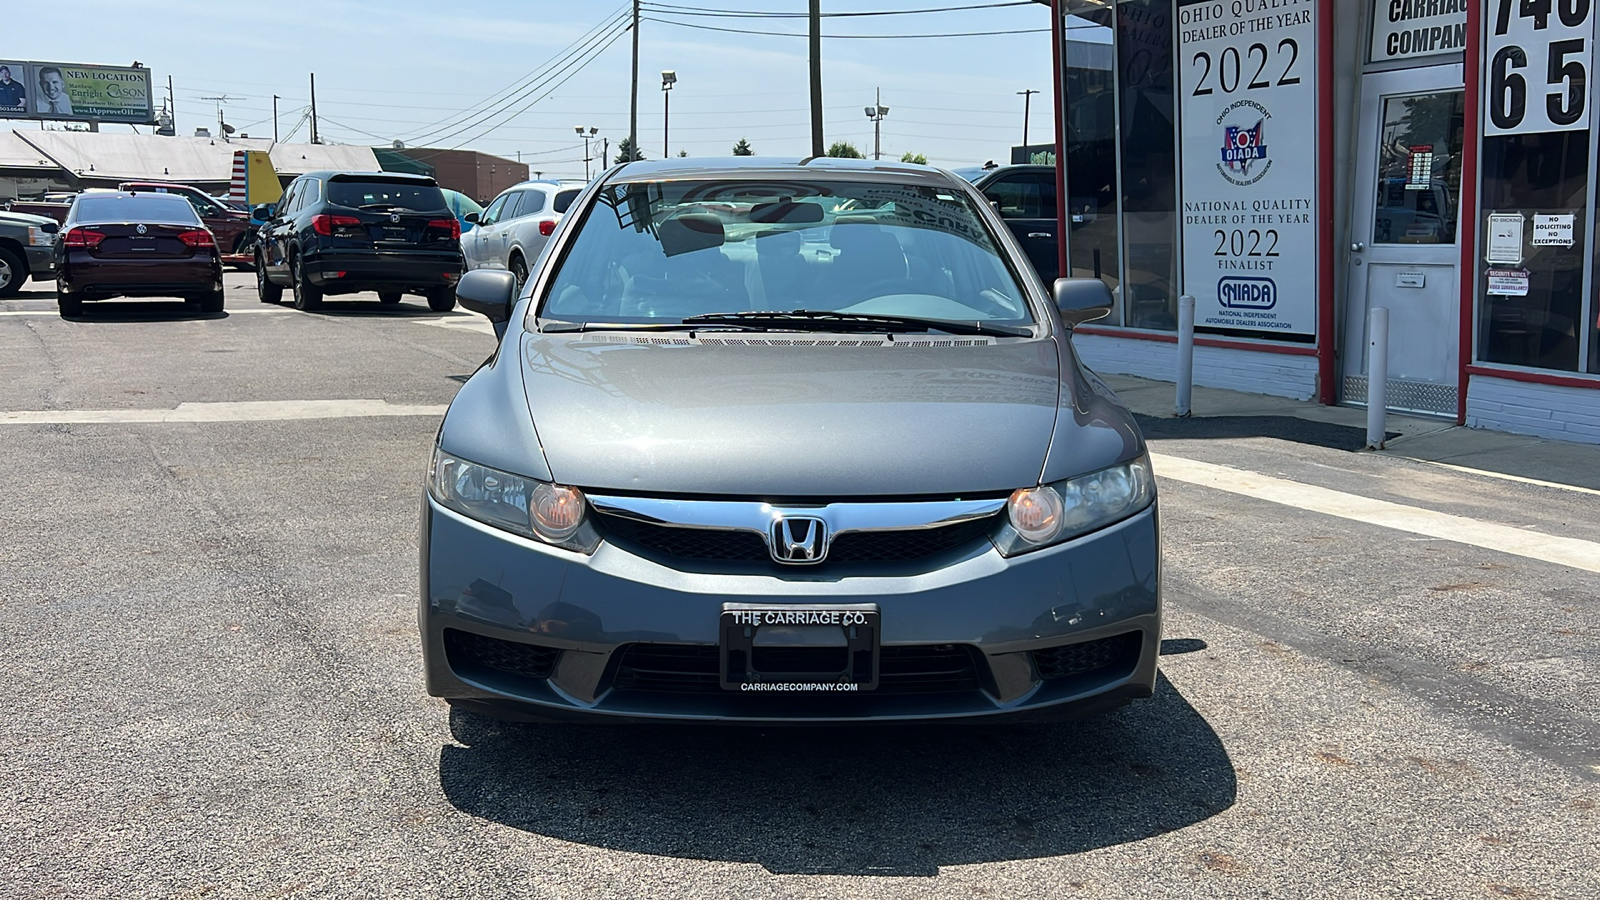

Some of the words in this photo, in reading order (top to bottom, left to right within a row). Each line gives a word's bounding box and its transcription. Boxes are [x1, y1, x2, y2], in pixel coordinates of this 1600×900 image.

[1180, 3, 1223, 25] OHIO
[1231, 0, 1311, 18] QUAL
[1388, 0, 1467, 23] CARRIA
[1182, 24, 1227, 44] DEALER
[1229, 20, 1246, 36] OF
[1248, 16, 1274, 33] THE
[1276, 9, 1311, 28] YEAR
[1386, 22, 1467, 56] COMPAN
[1191, 38, 1301, 97] 2022
[66, 71, 90, 79] NEW
[92, 72, 144, 82] LOCATION
[71, 89, 103, 99] Enright
[106, 83, 146, 99] CASON
[1216, 107, 1231, 125] OHIO
[1230, 99, 1273, 120] INDEPENDENT
[1226, 147, 1259, 160] OIADA
[1235, 179, 1253, 187] DEALERS
[1252, 159, 1273, 184] ASSOCIATION
[1185, 201, 1247, 212] NATIONAL
[1252, 199, 1312, 212] QUALITY
[1186, 215, 1227, 225] DEALER
[1232, 214, 1246, 224] OF
[1251, 214, 1273, 224] THE
[1278, 213, 1309, 224] YEAR
[1213, 229, 1280, 257] 2022
[1218, 260, 1274, 271] FINALIST
[1222, 283, 1271, 303] NIADA
[1218, 310, 1242, 318] NATIONAL
[1243, 312, 1277, 320] INDEPENDENT
[1205, 318, 1235, 326] AUTOMOBILE
[1236, 319, 1257, 327] DEALERS
[1257, 321, 1292, 330] ASSOCIATION
[733, 611, 762, 625] THE
[765, 611, 840, 625] CARRIAGE
[845, 611, 868, 625] CO.
[740, 682, 858, 691] CARRIAGECOMPANY.COM
